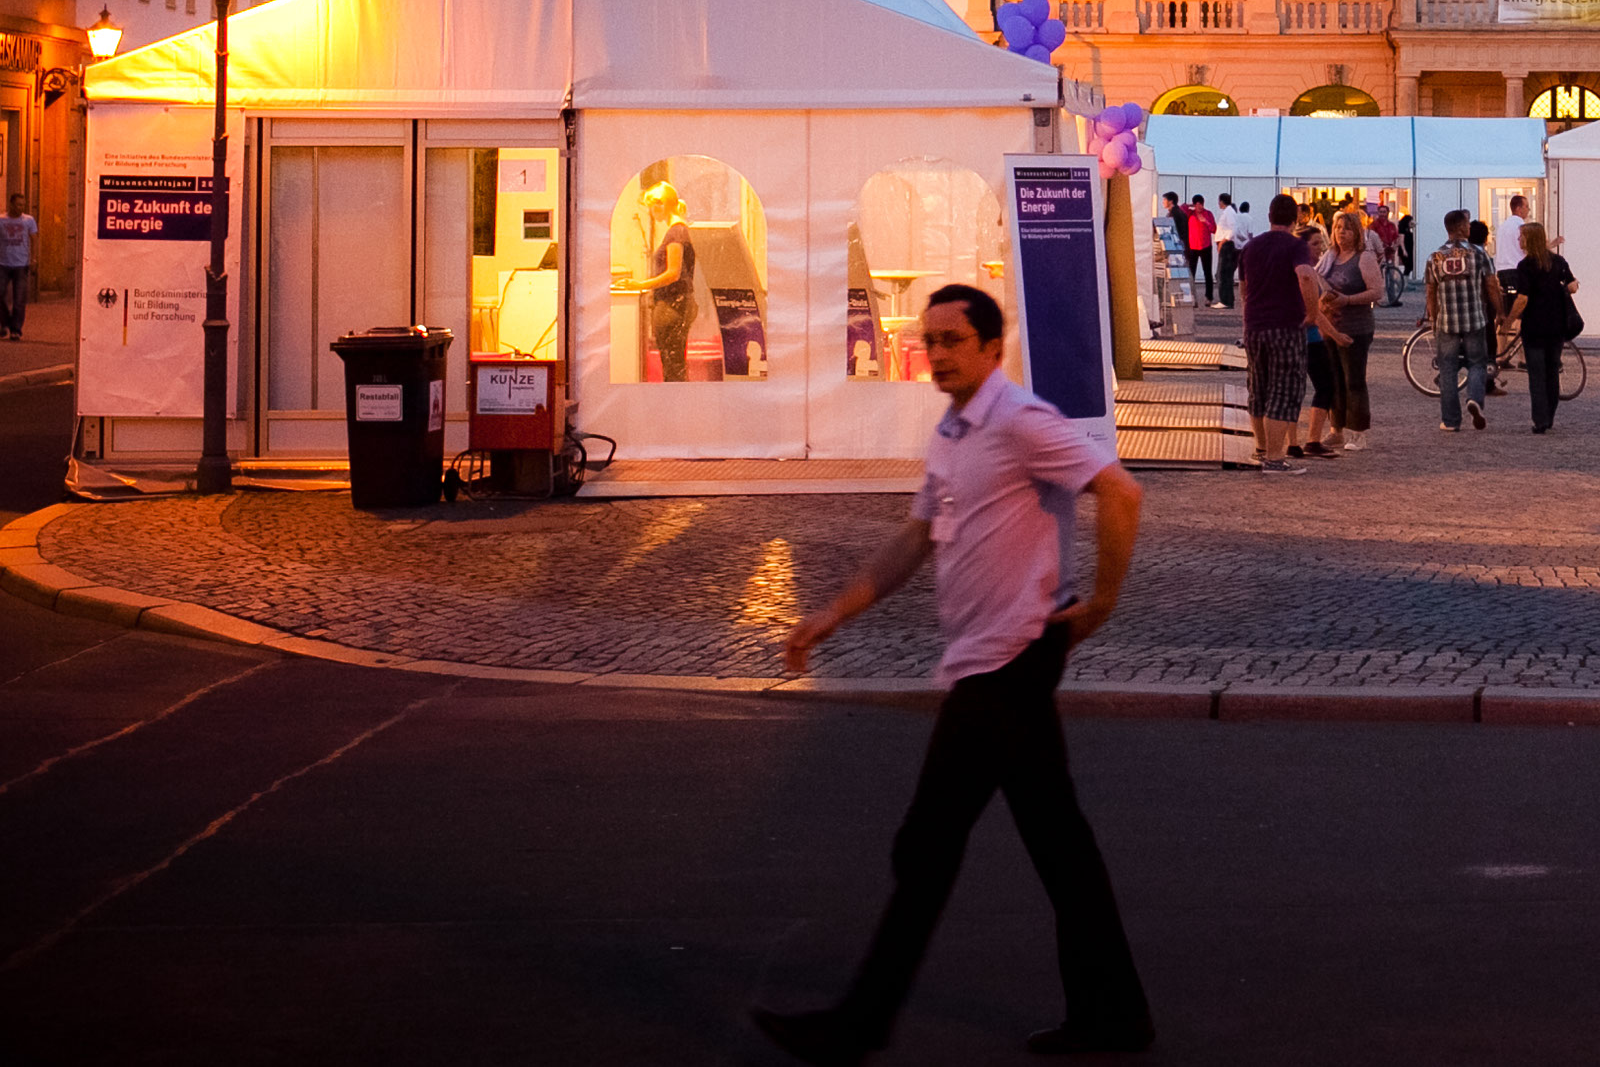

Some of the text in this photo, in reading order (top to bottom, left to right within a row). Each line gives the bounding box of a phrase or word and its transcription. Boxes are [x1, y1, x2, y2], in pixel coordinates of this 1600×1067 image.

[103, 179, 192, 189] Wissenschaftsjahr
[1020, 187, 1087, 199] Die Zukunft der
[106, 199, 213, 214] Die Zukunft de
[1021, 201, 1056, 215] Energie
[106, 216, 163, 233] Energie
[133, 288, 207, 299] Bundesministeriu
[133, 300, 180, 311] für Bildung
[133, 312, 196, 323] und Forschung
[360, 393, 399, 401] Restabfall
